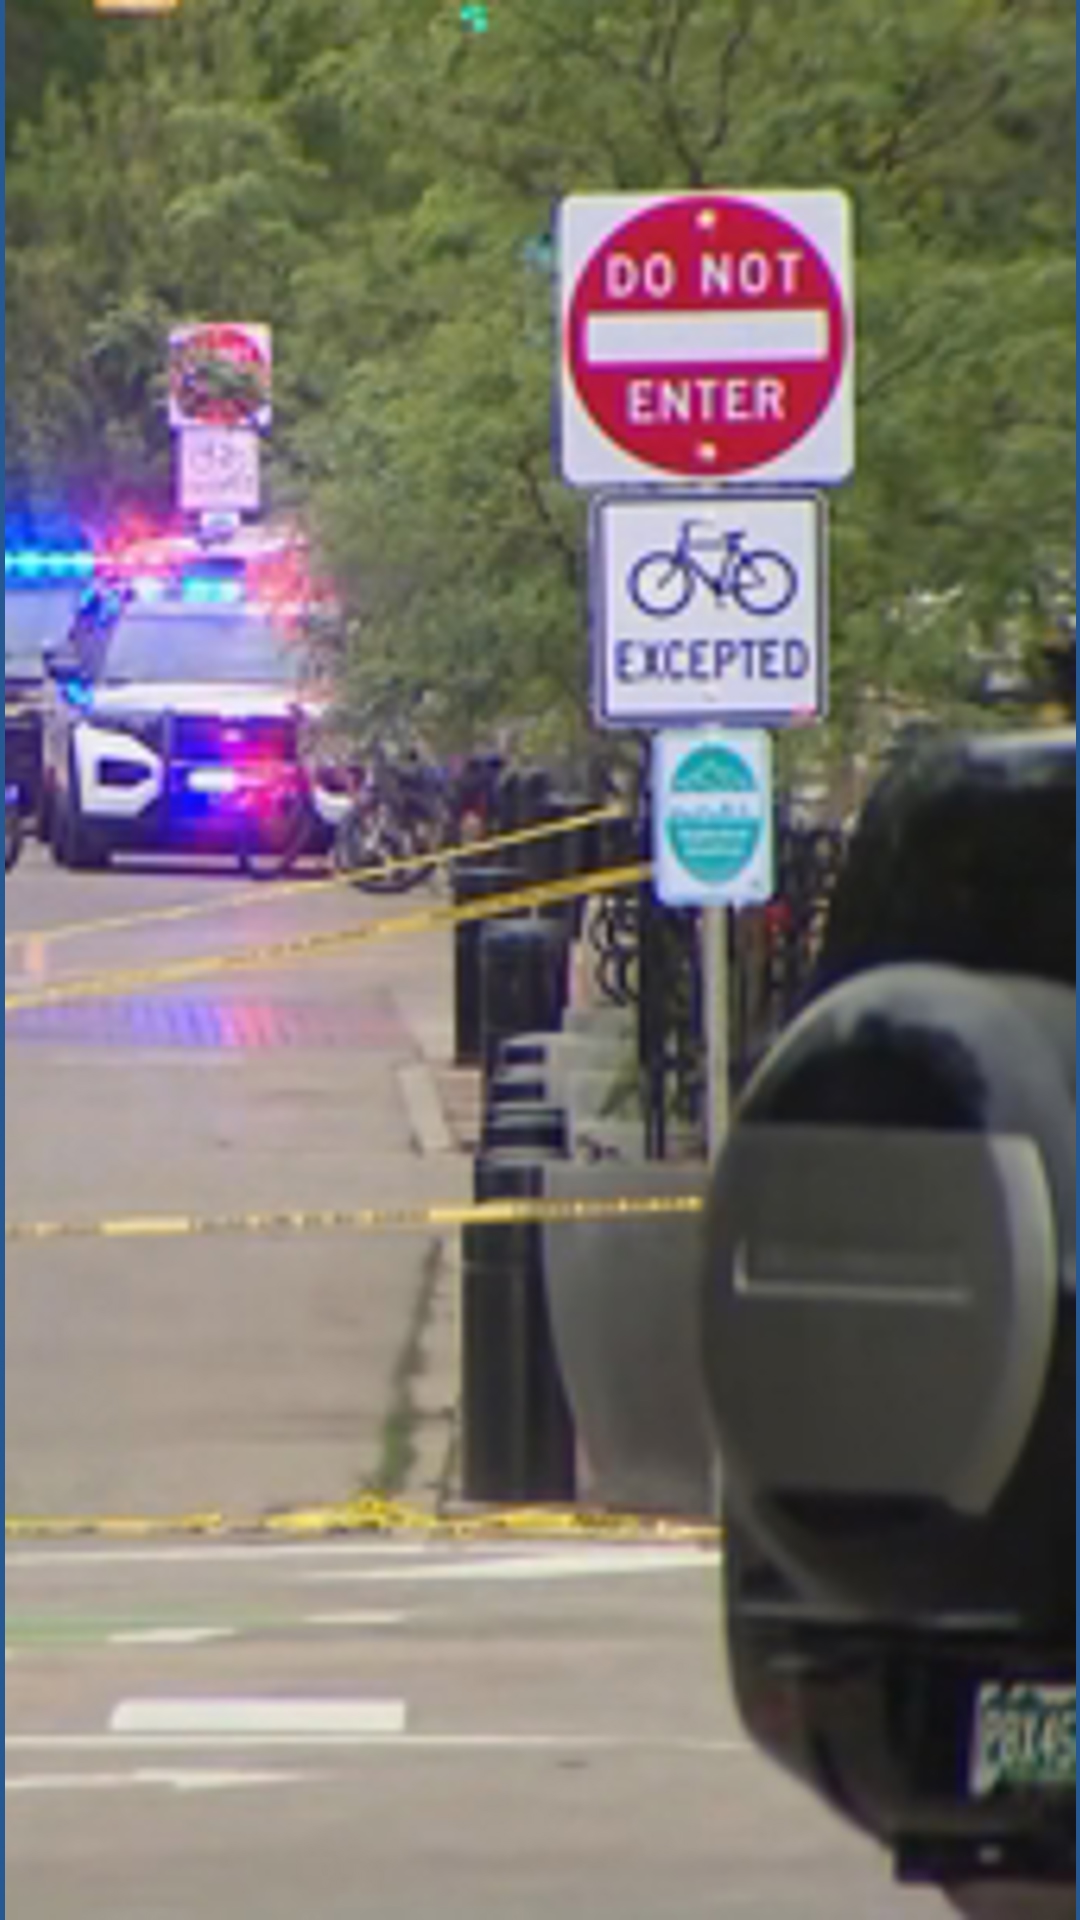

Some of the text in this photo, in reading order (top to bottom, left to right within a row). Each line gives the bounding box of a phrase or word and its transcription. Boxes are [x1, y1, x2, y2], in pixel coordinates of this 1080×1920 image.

[604, 250, 803, 298] DO NOT
[627, 376, 786, 425] ENTER
[614, 638, 811, 683] EXCEPTED
